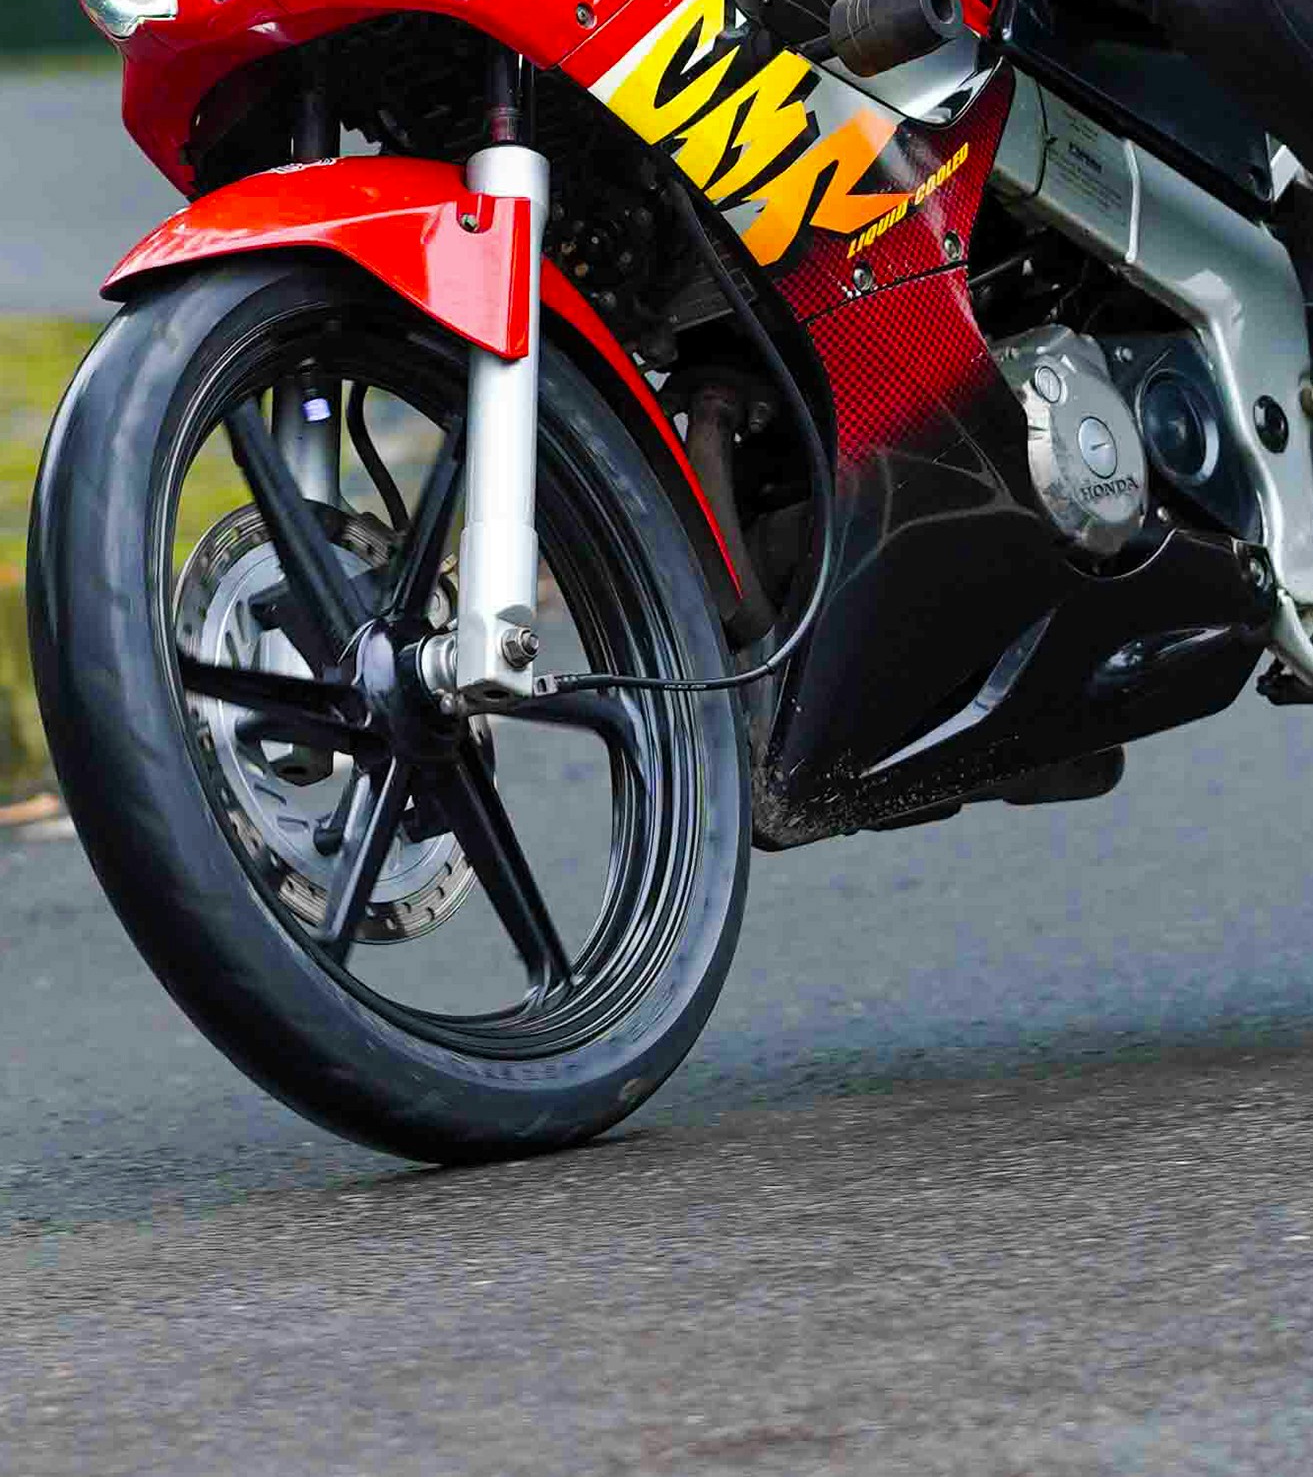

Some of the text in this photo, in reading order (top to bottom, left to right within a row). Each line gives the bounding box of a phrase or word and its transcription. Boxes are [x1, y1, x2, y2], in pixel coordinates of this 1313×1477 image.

[846, 141, 970, 260] LIQUID COOLED
[1079, 475, 1140, 501] HONDA
